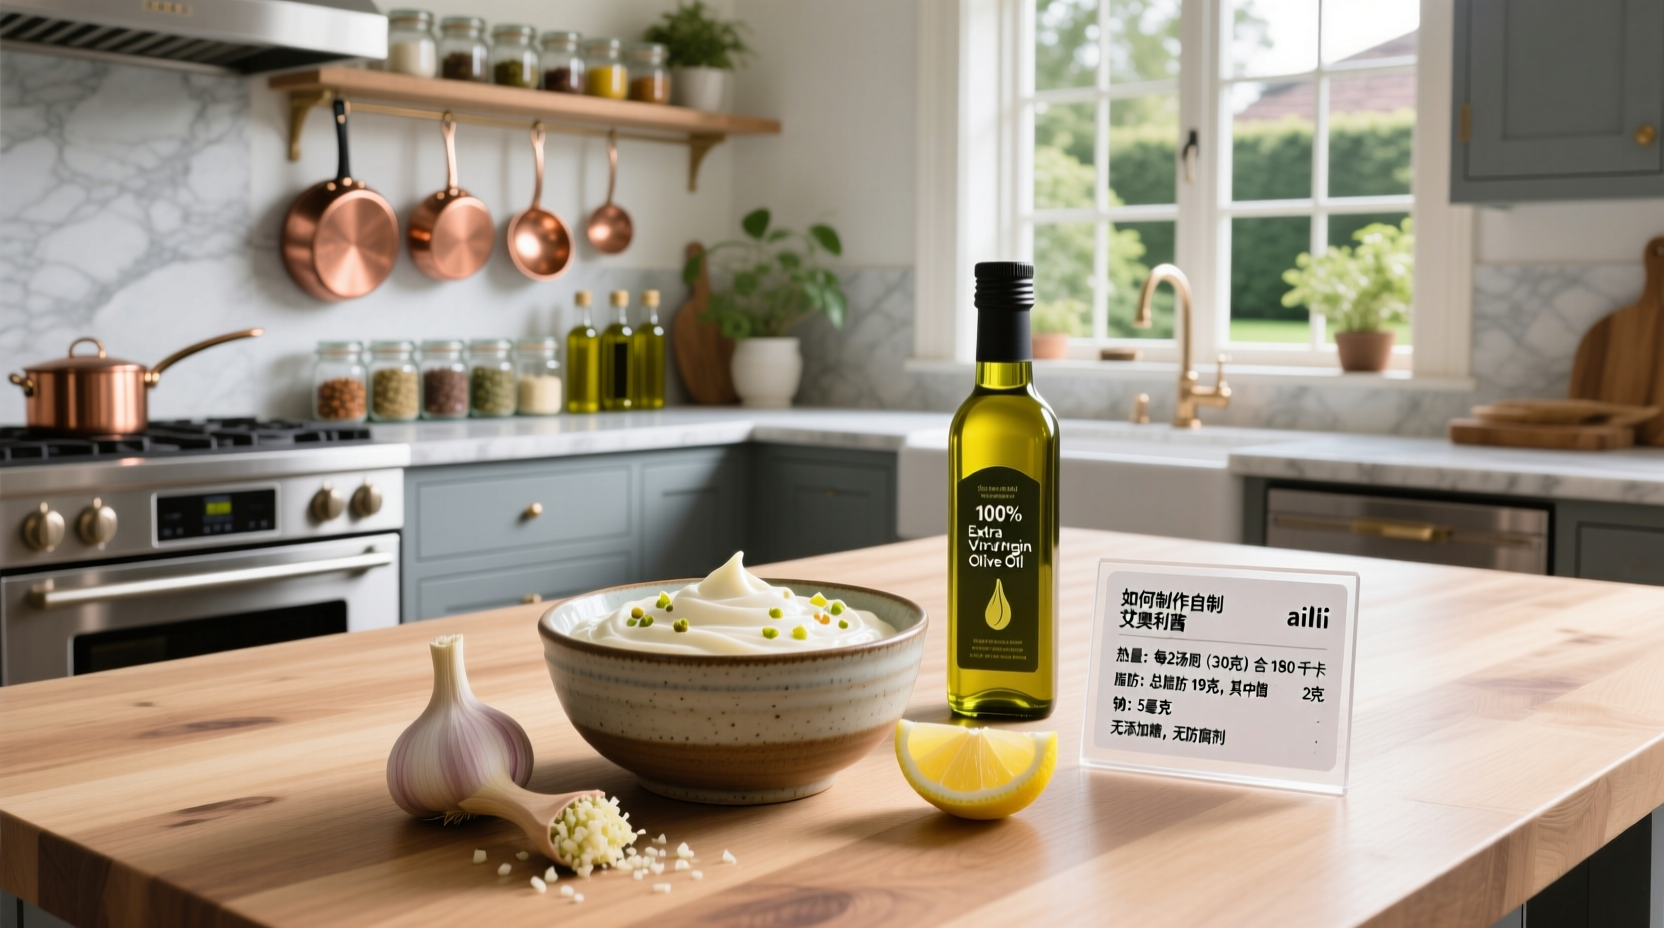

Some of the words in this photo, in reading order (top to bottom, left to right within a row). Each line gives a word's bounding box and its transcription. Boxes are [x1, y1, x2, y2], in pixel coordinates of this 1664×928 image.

[976, 504, 1022, 522] 100%
[968, 524, 1003, 538] Extra
[968, 554, 1003, 568] Olive
[1120, 588, 1224, 614] 如何制作自制
